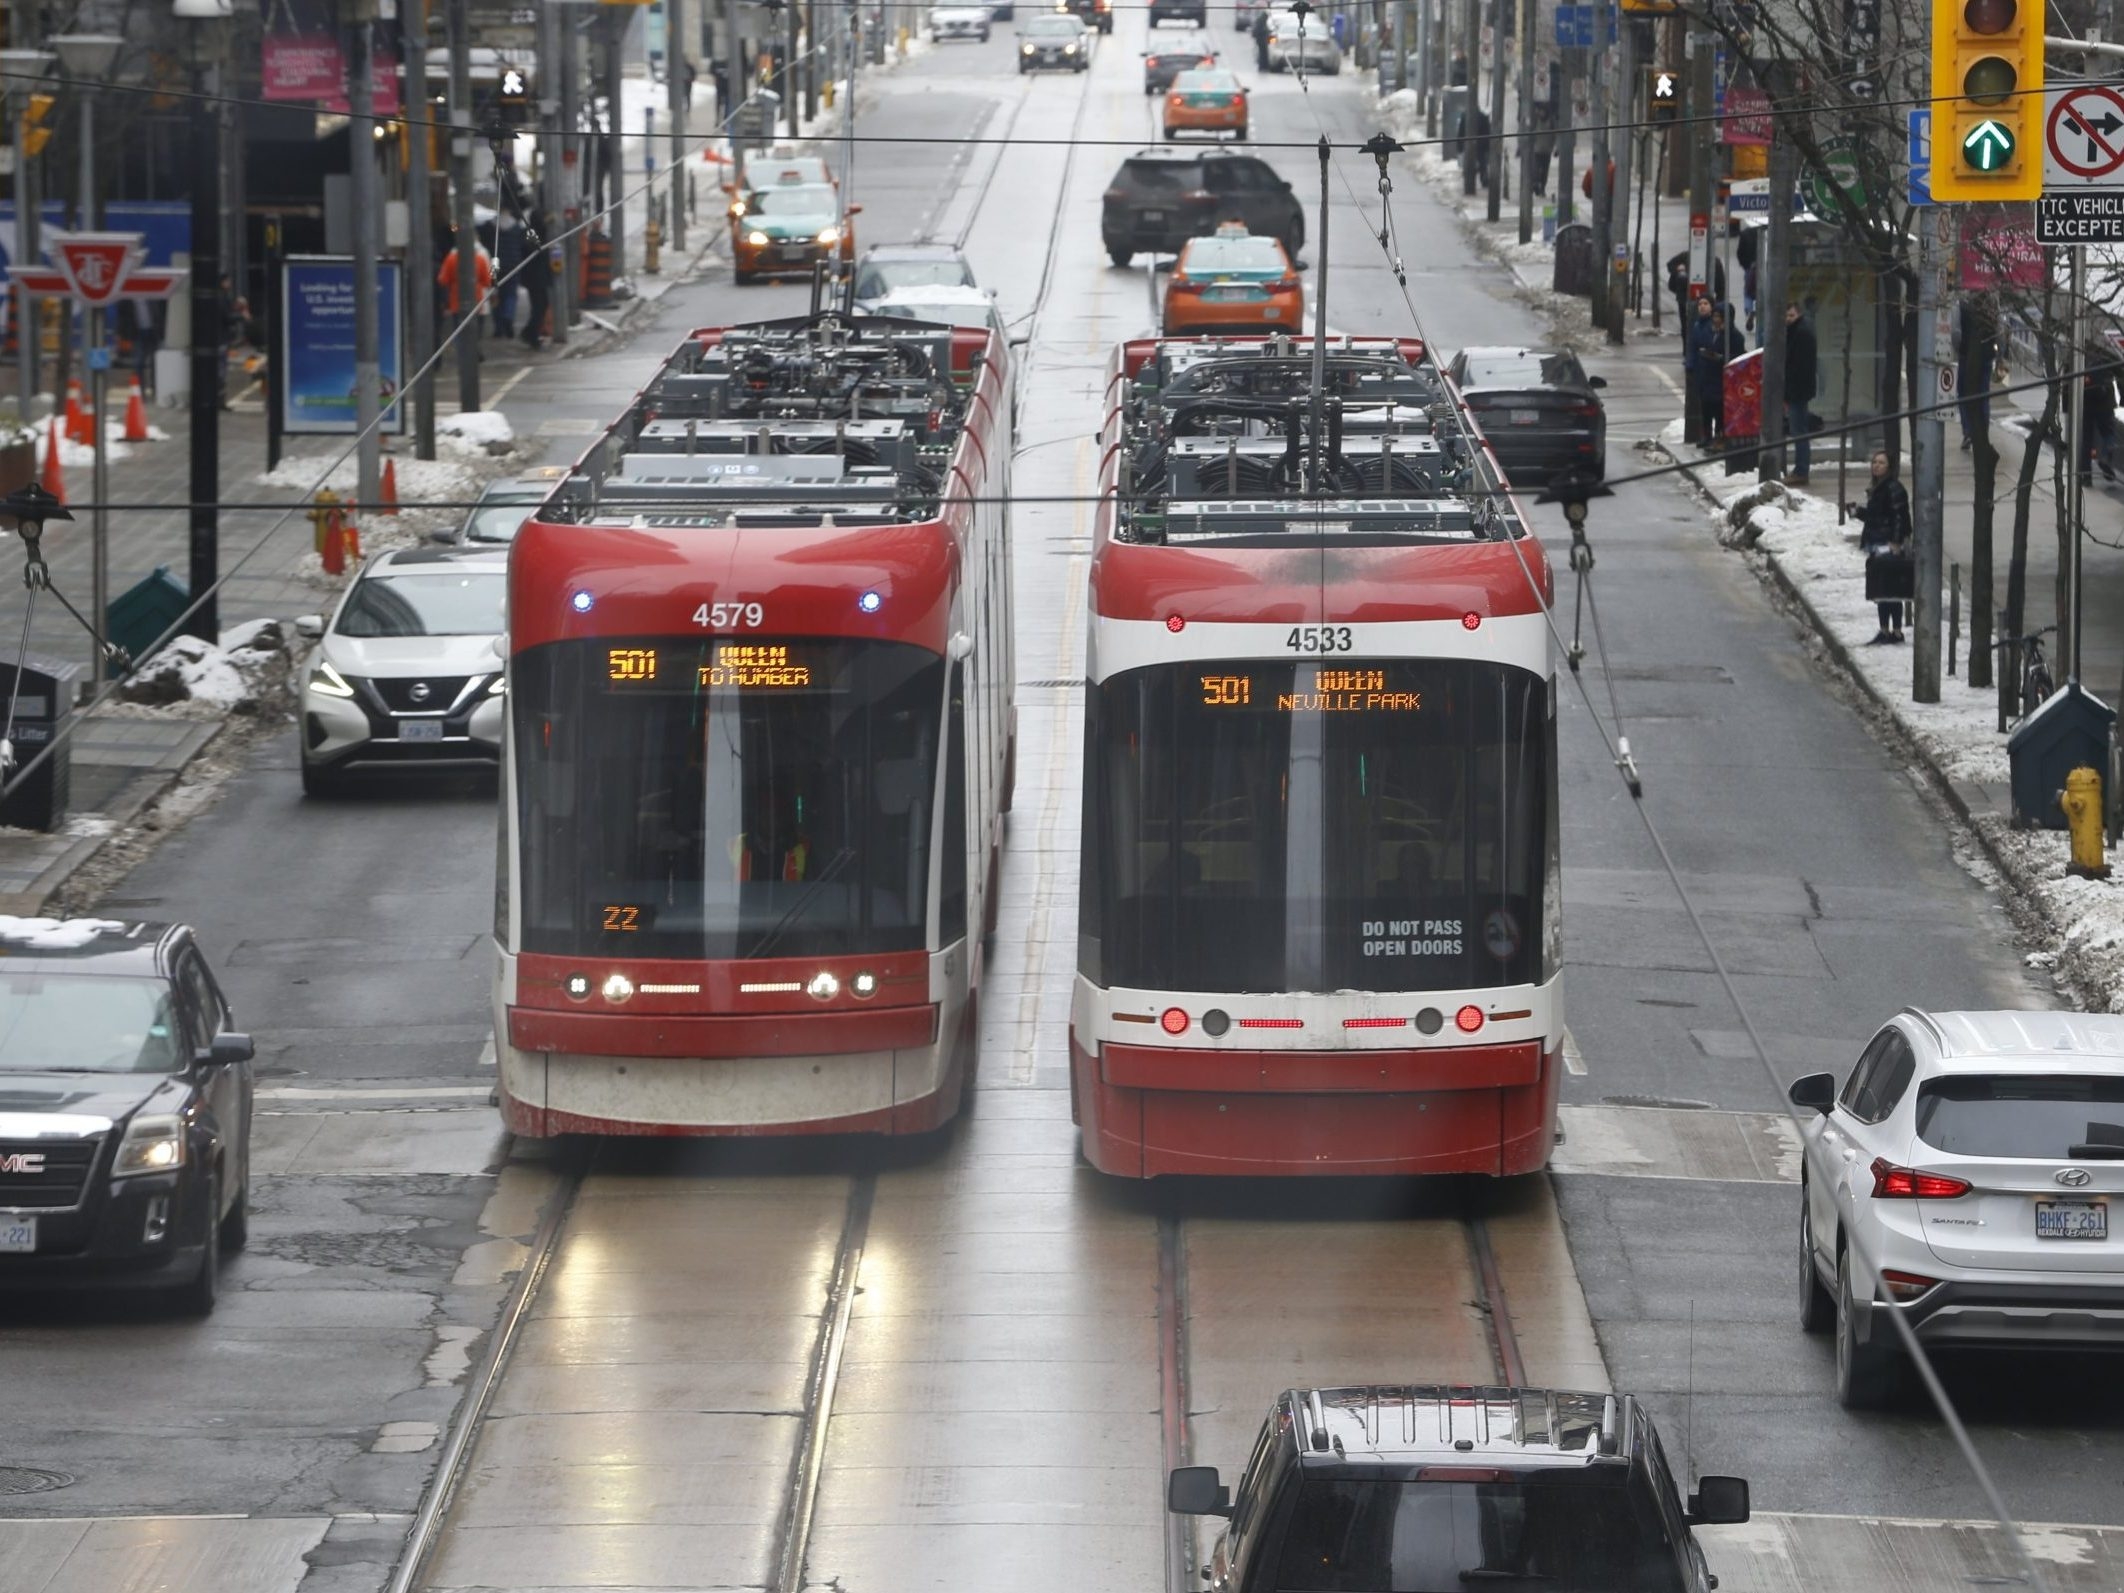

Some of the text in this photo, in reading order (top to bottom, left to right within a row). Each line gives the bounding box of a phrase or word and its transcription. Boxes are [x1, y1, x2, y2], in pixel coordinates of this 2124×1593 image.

[2041, 199, 2067, 215] TTC
[692, 602, 763, 628] 4579
[1286, 627, 1352, 652] 4533
[609, 650, 656, 679] 501
[719, 646, 787, 668] QUEEN
[698, 667, 810, 686] TO HUMBER
[1316, 670, 1384, 692] QUEEN
[1203, 676, 1250, 704] 501
[1278, 693, 1421, 711] NEVILLE PARK
[1362, 920, 1463, 937] DO NOT PASS
[1363, 940, 1463, 956] OPEN DOORS
